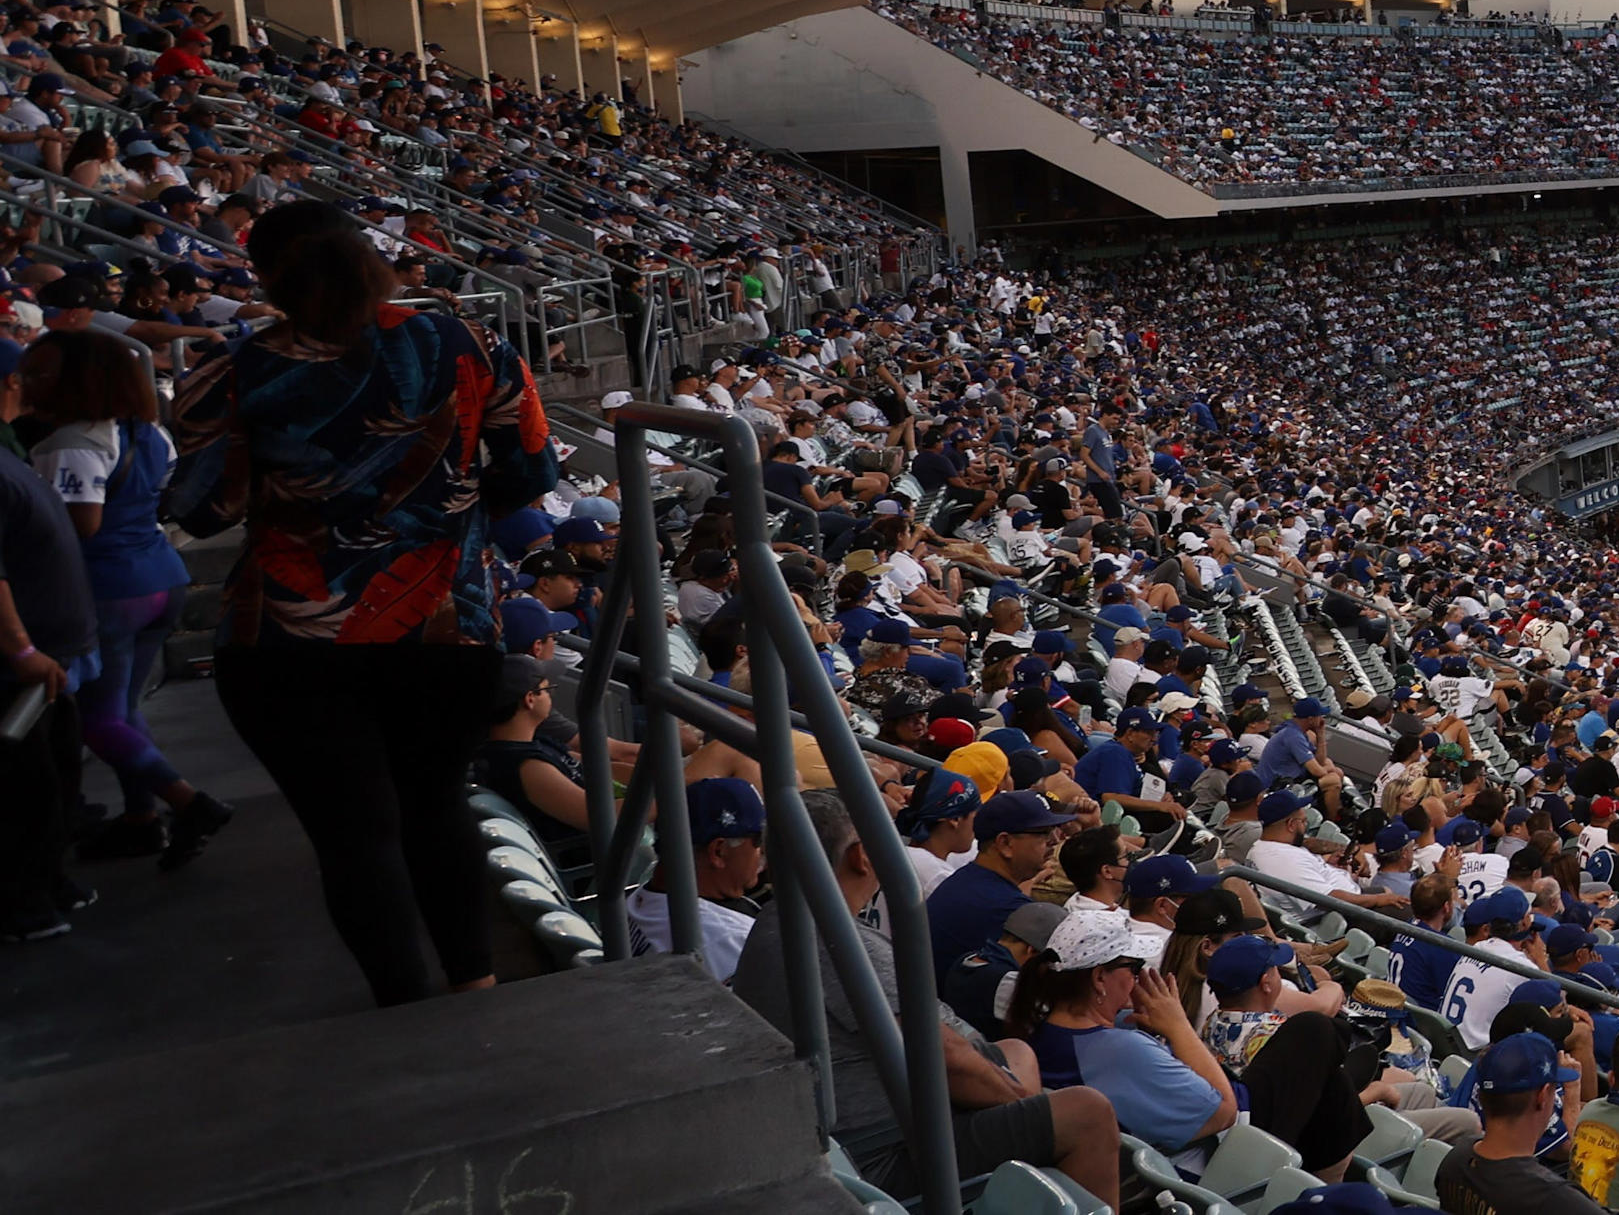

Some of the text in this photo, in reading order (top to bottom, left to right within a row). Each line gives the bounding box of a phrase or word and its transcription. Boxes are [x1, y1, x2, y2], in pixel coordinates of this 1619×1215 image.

[60, 467, 83, 494] LA
[1011, 544, 1026, 559] 35
[1536, 625, 1553, 637] 27
